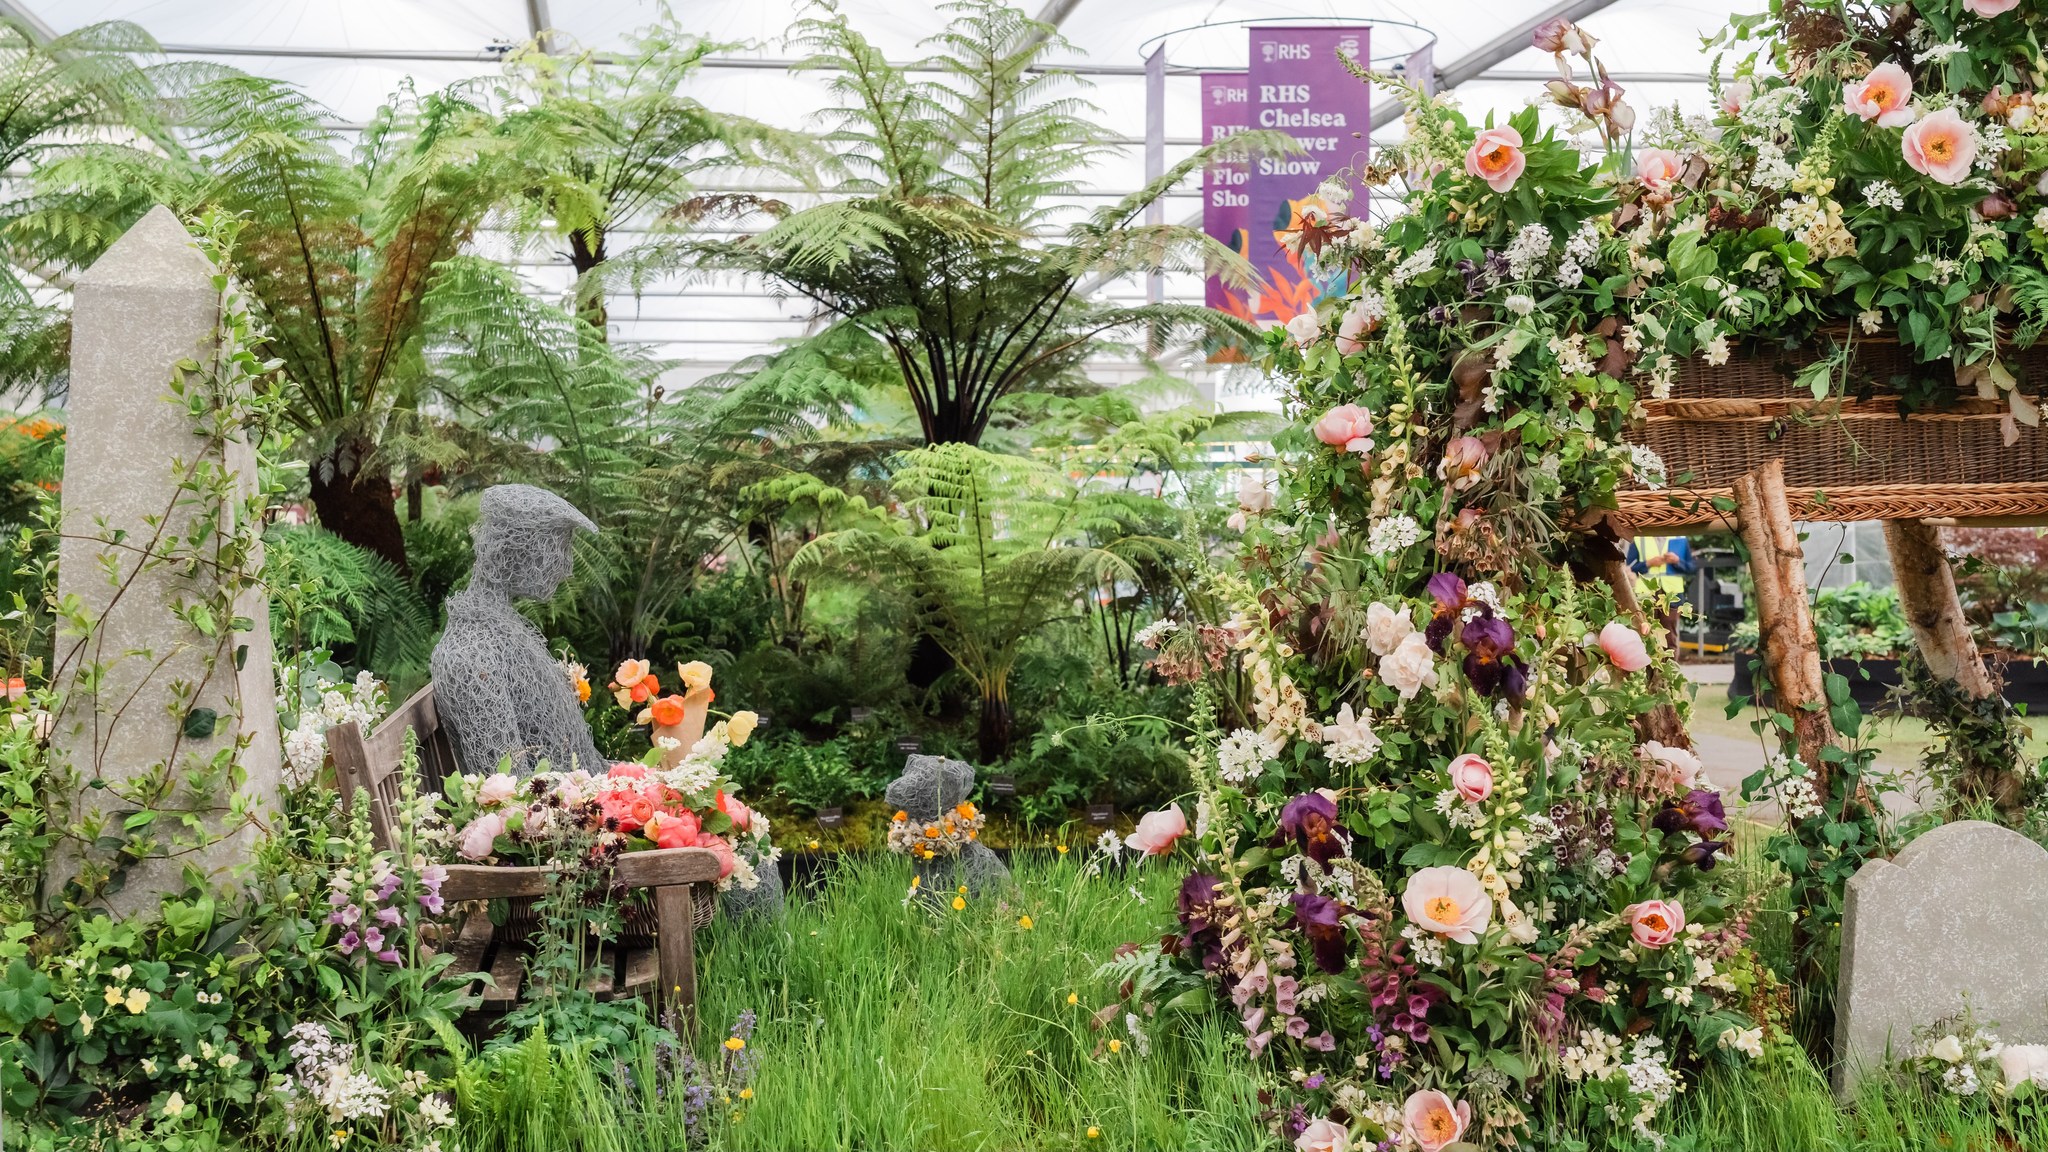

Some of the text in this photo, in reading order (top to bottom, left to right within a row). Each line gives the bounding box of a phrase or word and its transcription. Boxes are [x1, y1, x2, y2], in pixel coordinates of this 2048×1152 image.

[1278, 44, 1311, 60] RHS
[1226, 89, 1248, 103] RH
[1259, 85, 1311, 104] RHS
[1259, 108, 1347, 128] Chelsea
[1259, 157, 1321, 176] Show
[1212, 168, 1249, 186] Flo
[1211, 190, 1249, 208] Sho
